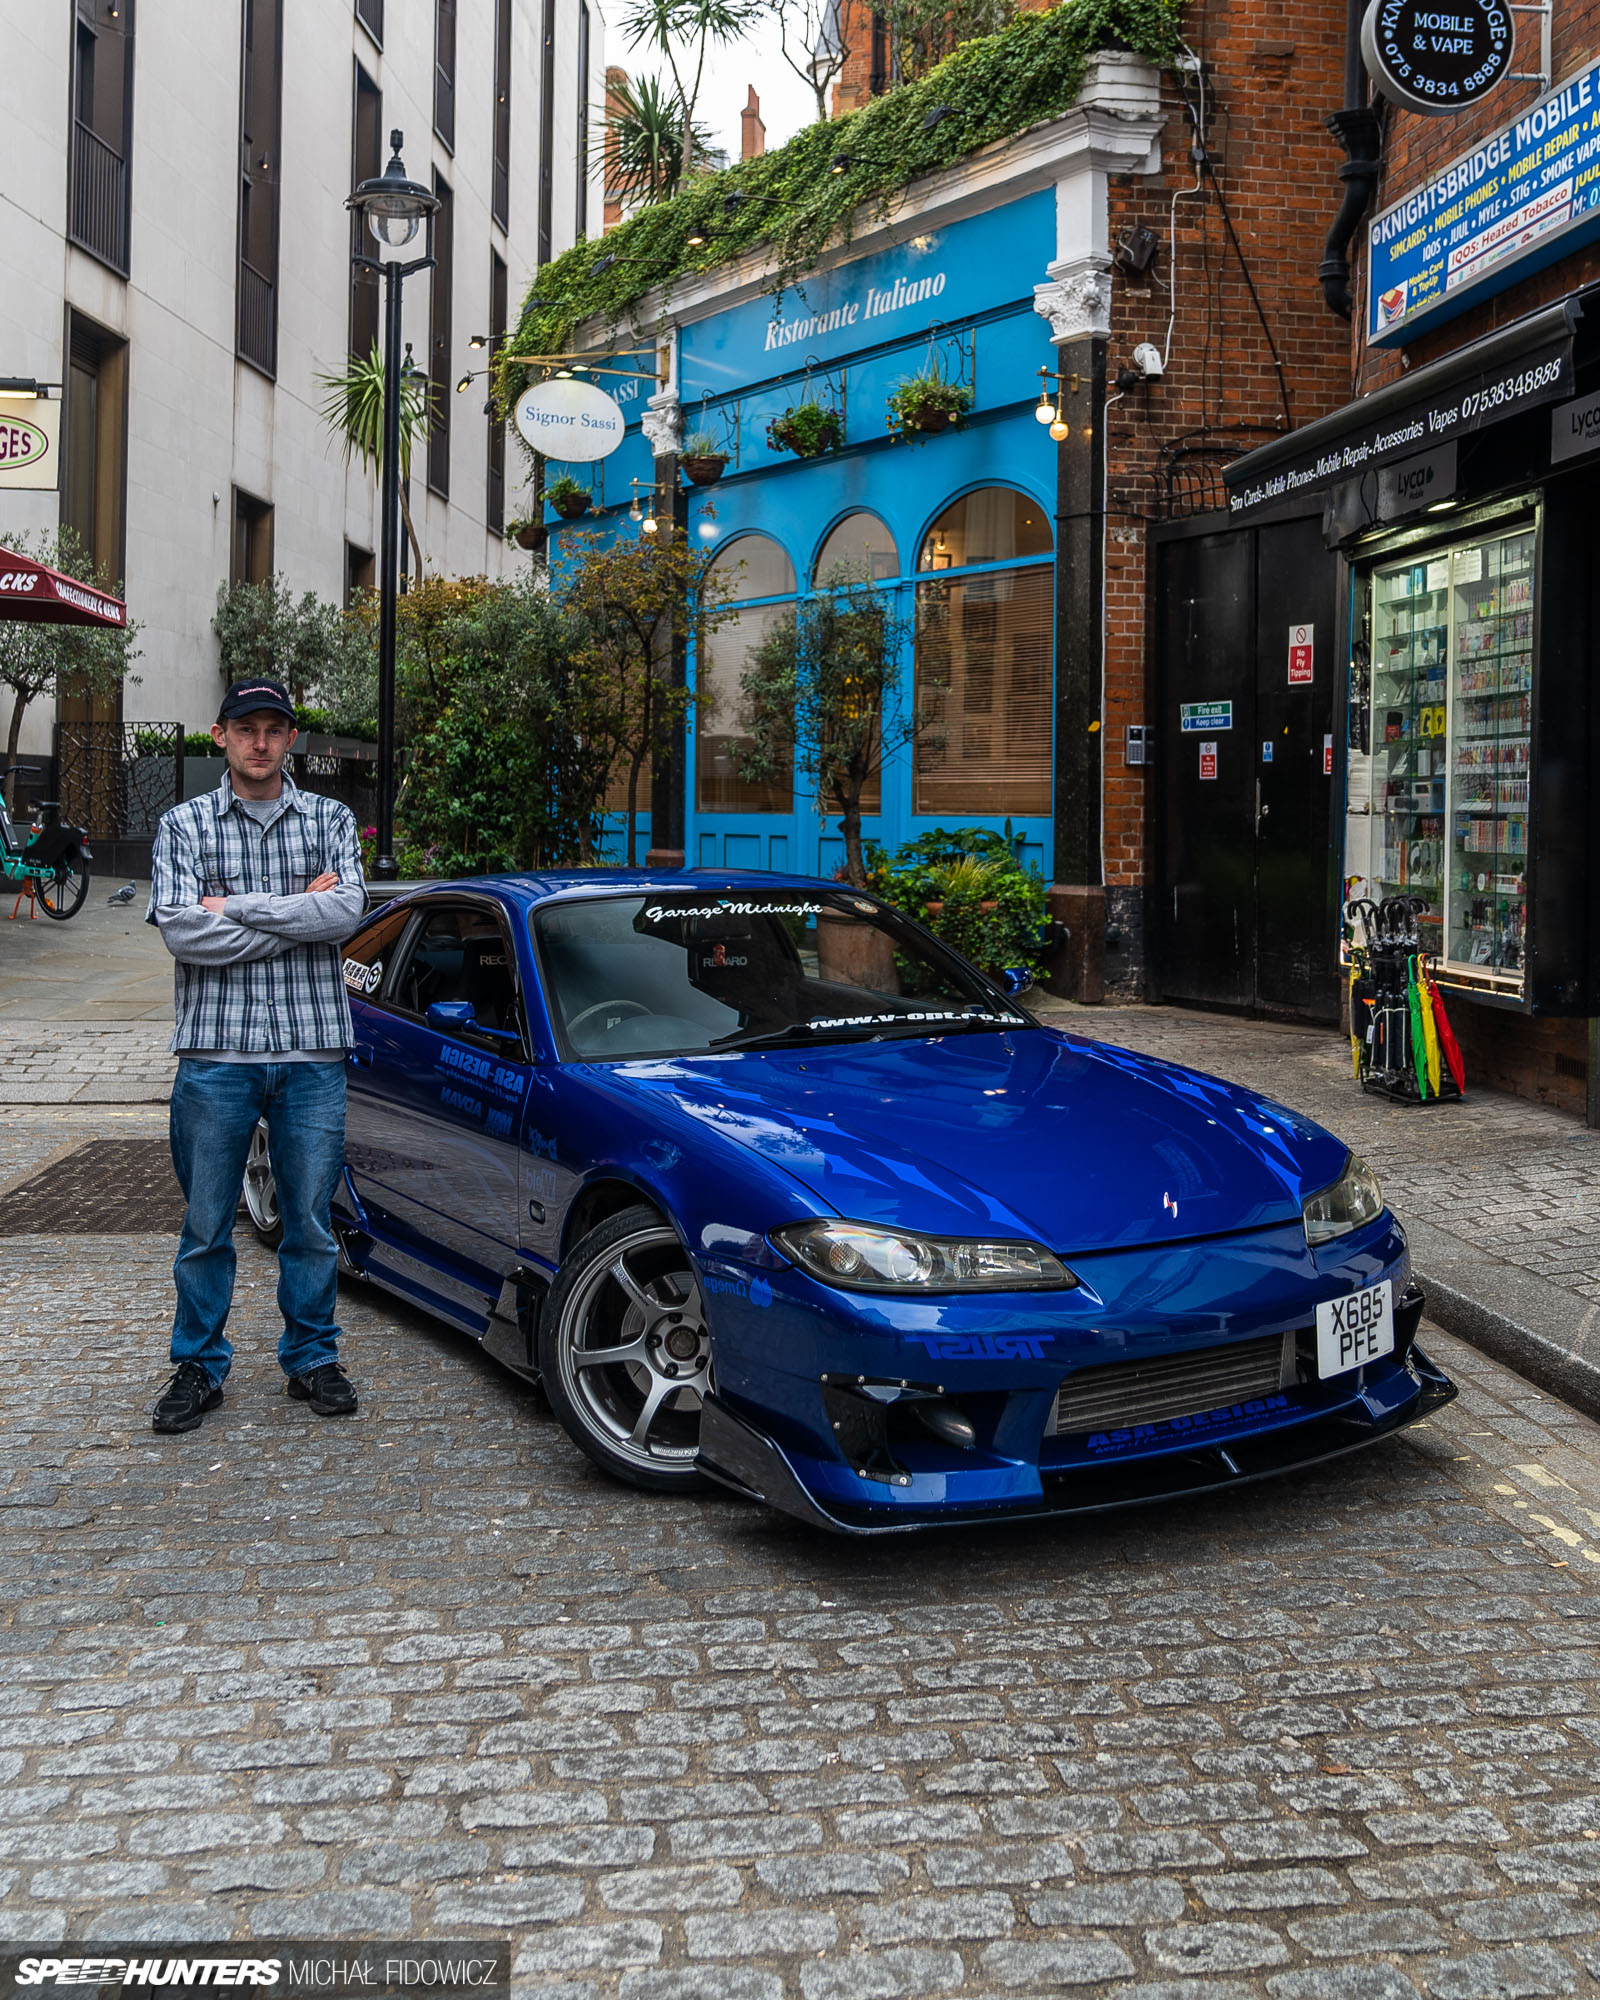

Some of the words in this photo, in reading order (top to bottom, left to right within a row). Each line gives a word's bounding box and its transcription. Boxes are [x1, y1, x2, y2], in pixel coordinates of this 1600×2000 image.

[1413, 34, 1427, 51] &
[1431, 36, 1474, 55] VAPE
[1414, 12, 1475, 33] MOBILE
[1385, 43, 1412, 77] 075
[1412, 74, 1460, 96] 3834
[1463, 53, 1501, 91] 8888
[1381, 130, 1511, 243] KNIGHTSBRIDGE
[1515, 74, 1592, 152] MOBILE
[1389, 225, 1427, 262] SIMCARDS
[1434, 200, 1464, 232] MOBILE
[1465, 176, 1499, 212] PHONES
[1508, 147, 1542, 184] MOBILE
[1544, 123, 1580, 161] REPAIR
[1449, 220, 1469, 246] JUUL
[1478, 198, 1501, 227] MYLE
[1510, 180, 1530, 206] STIG
[1540, 151, 1574, 188] SMOKE
[1452, 241, 1479, 265] IQOS:
[1481, 215, 1518, 248] Heated
[1522, 188, 1568, 222] Tobacco
[762, 303, 859, 352] Ristorante
[862, 272, 946, 322] Italiano
[525, 405, 577, 430] Signor
[581, 412, 616, 430] Sassi
[1230, 495, 1243, 512] Sim
[1428, 407, 1459, 433] Vapes
[1462, 357, 1562, 419] 07538348888
[1290, 668, 1311, 678] Tipping
[1296, 648, 1306, 657] No
[1296, 659, 1306, 668] Fly
[1196, 717, 1209, 727] Keep
[1210, 717, 1224, 726] clear
[1198, 706, 1209, 715] Fire
[1211, 705, 1222, 714] exit
[646, 904, 723, 923] Garage
[723, 902, 823, 915] Midnight
[1332, 1286, 1382, 1335] X685
[1340, 1321, 1378, 1366] PFE
[1087, 1394, 1288, 1450] ASR-DESIGN
